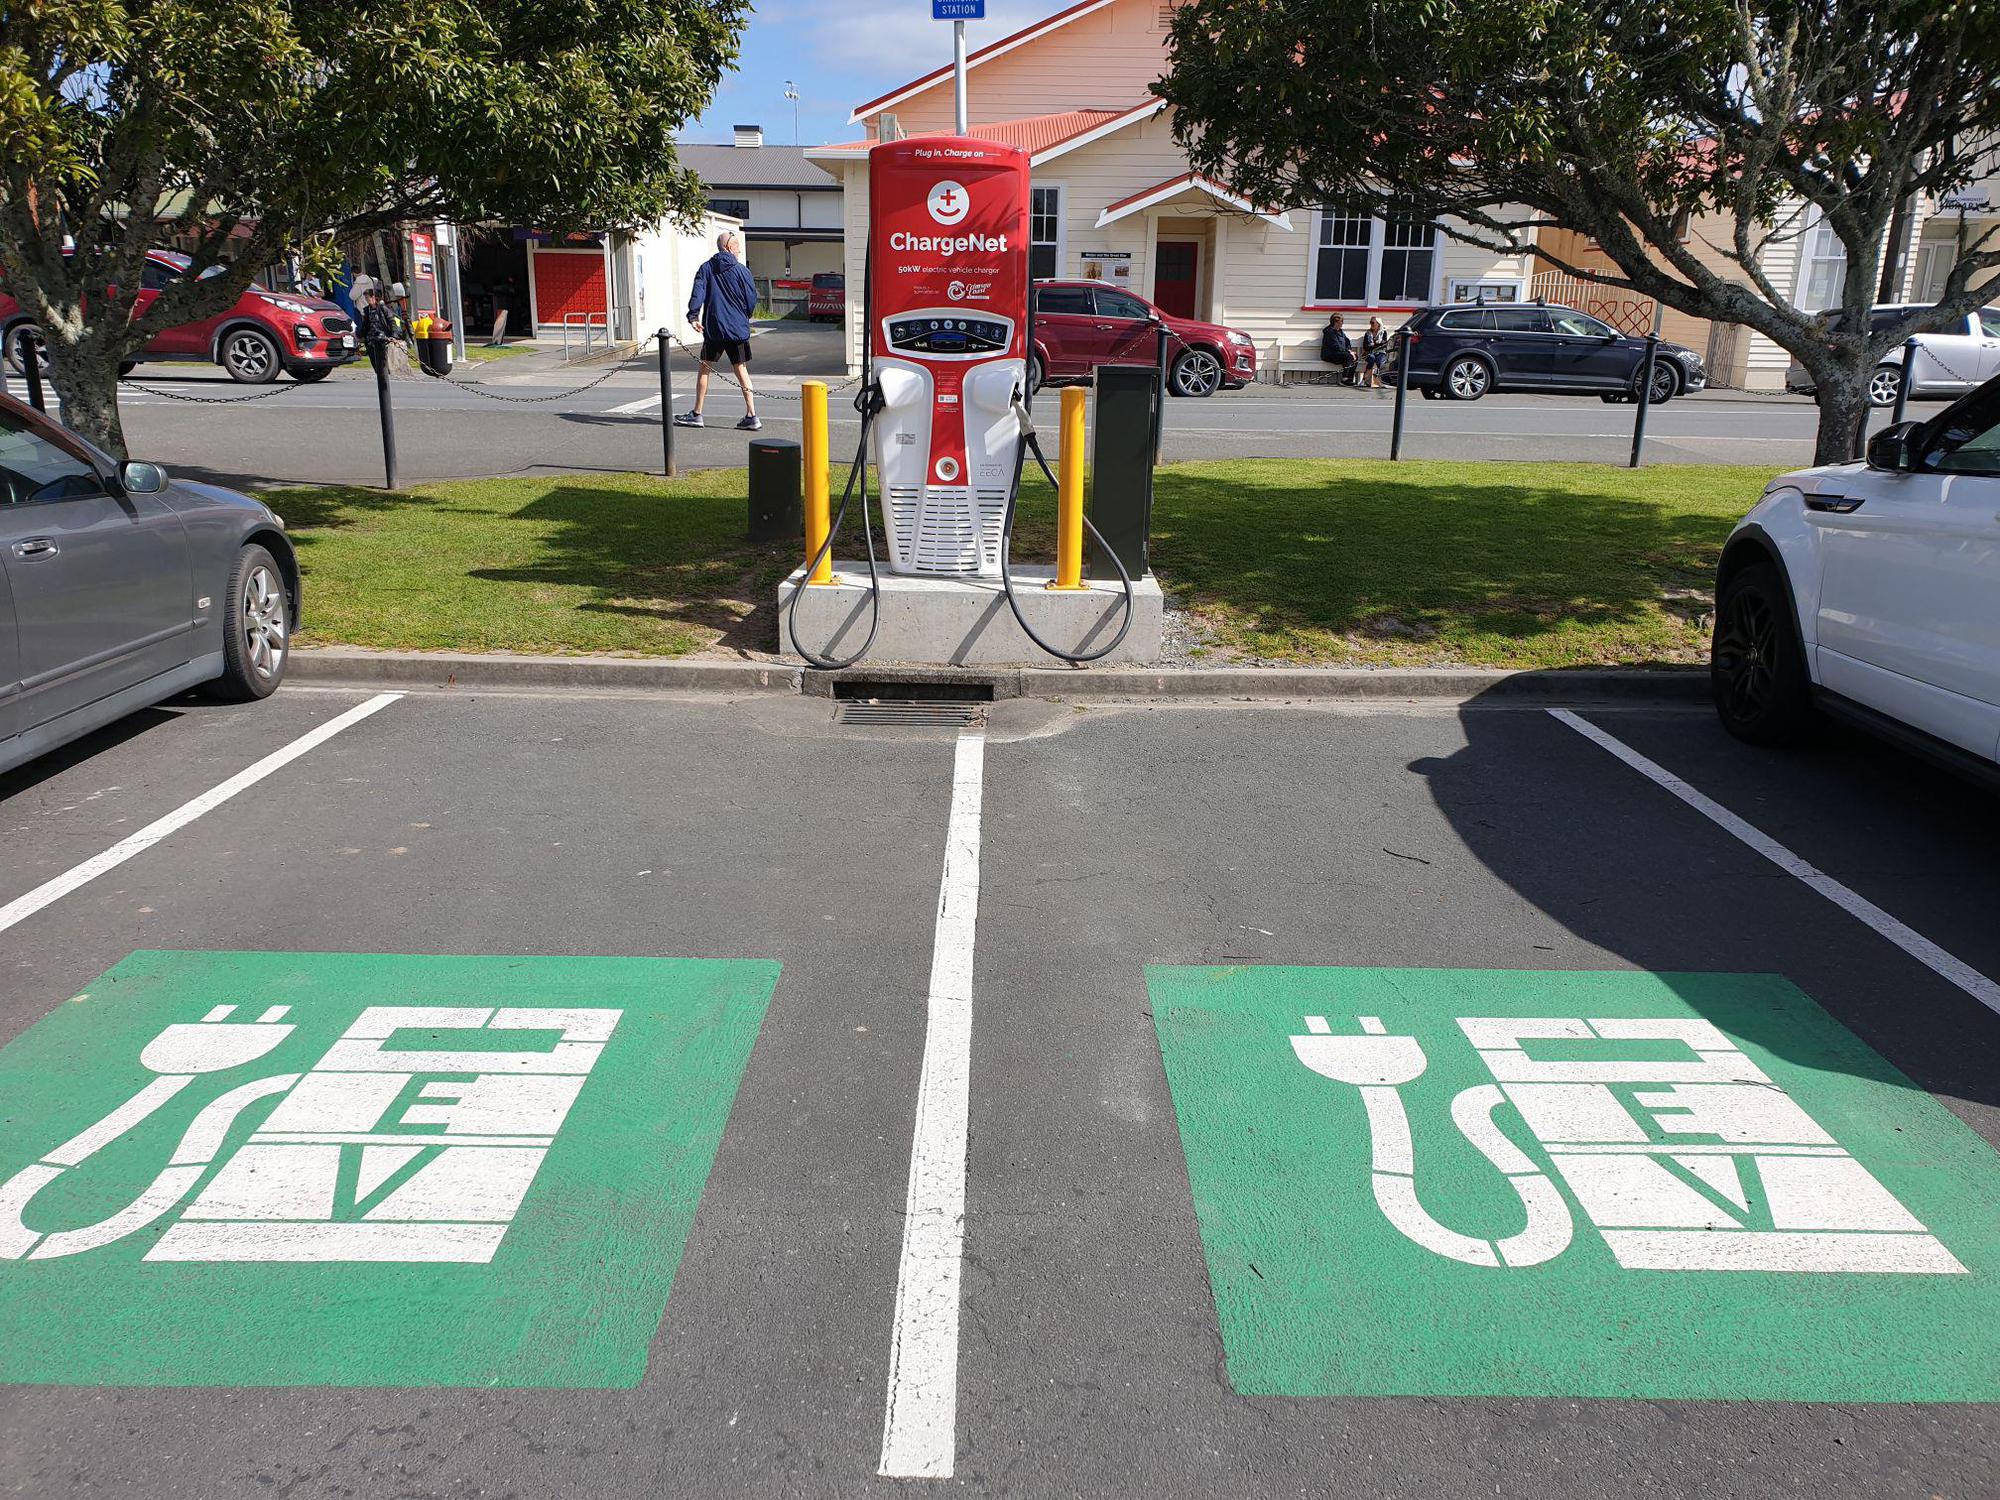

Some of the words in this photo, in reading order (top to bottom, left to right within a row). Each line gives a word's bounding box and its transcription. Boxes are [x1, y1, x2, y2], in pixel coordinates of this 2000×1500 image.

[942, 4, 976, 15] STATION
[915, 149, 931, 158] Plug
[944, 148, 971, 158] Charge
[890, 232, 1008, 256] ChargeNet
[898, 264, 921, 274] 50kW
[922, 265, 947, 274] electric
[949, 266, 973, 275] vehicle
[974, 267, 1000, 276] charger
[331, 1073, 480, 1221] EV
[1604, 1082, 1775, 1231] EV
